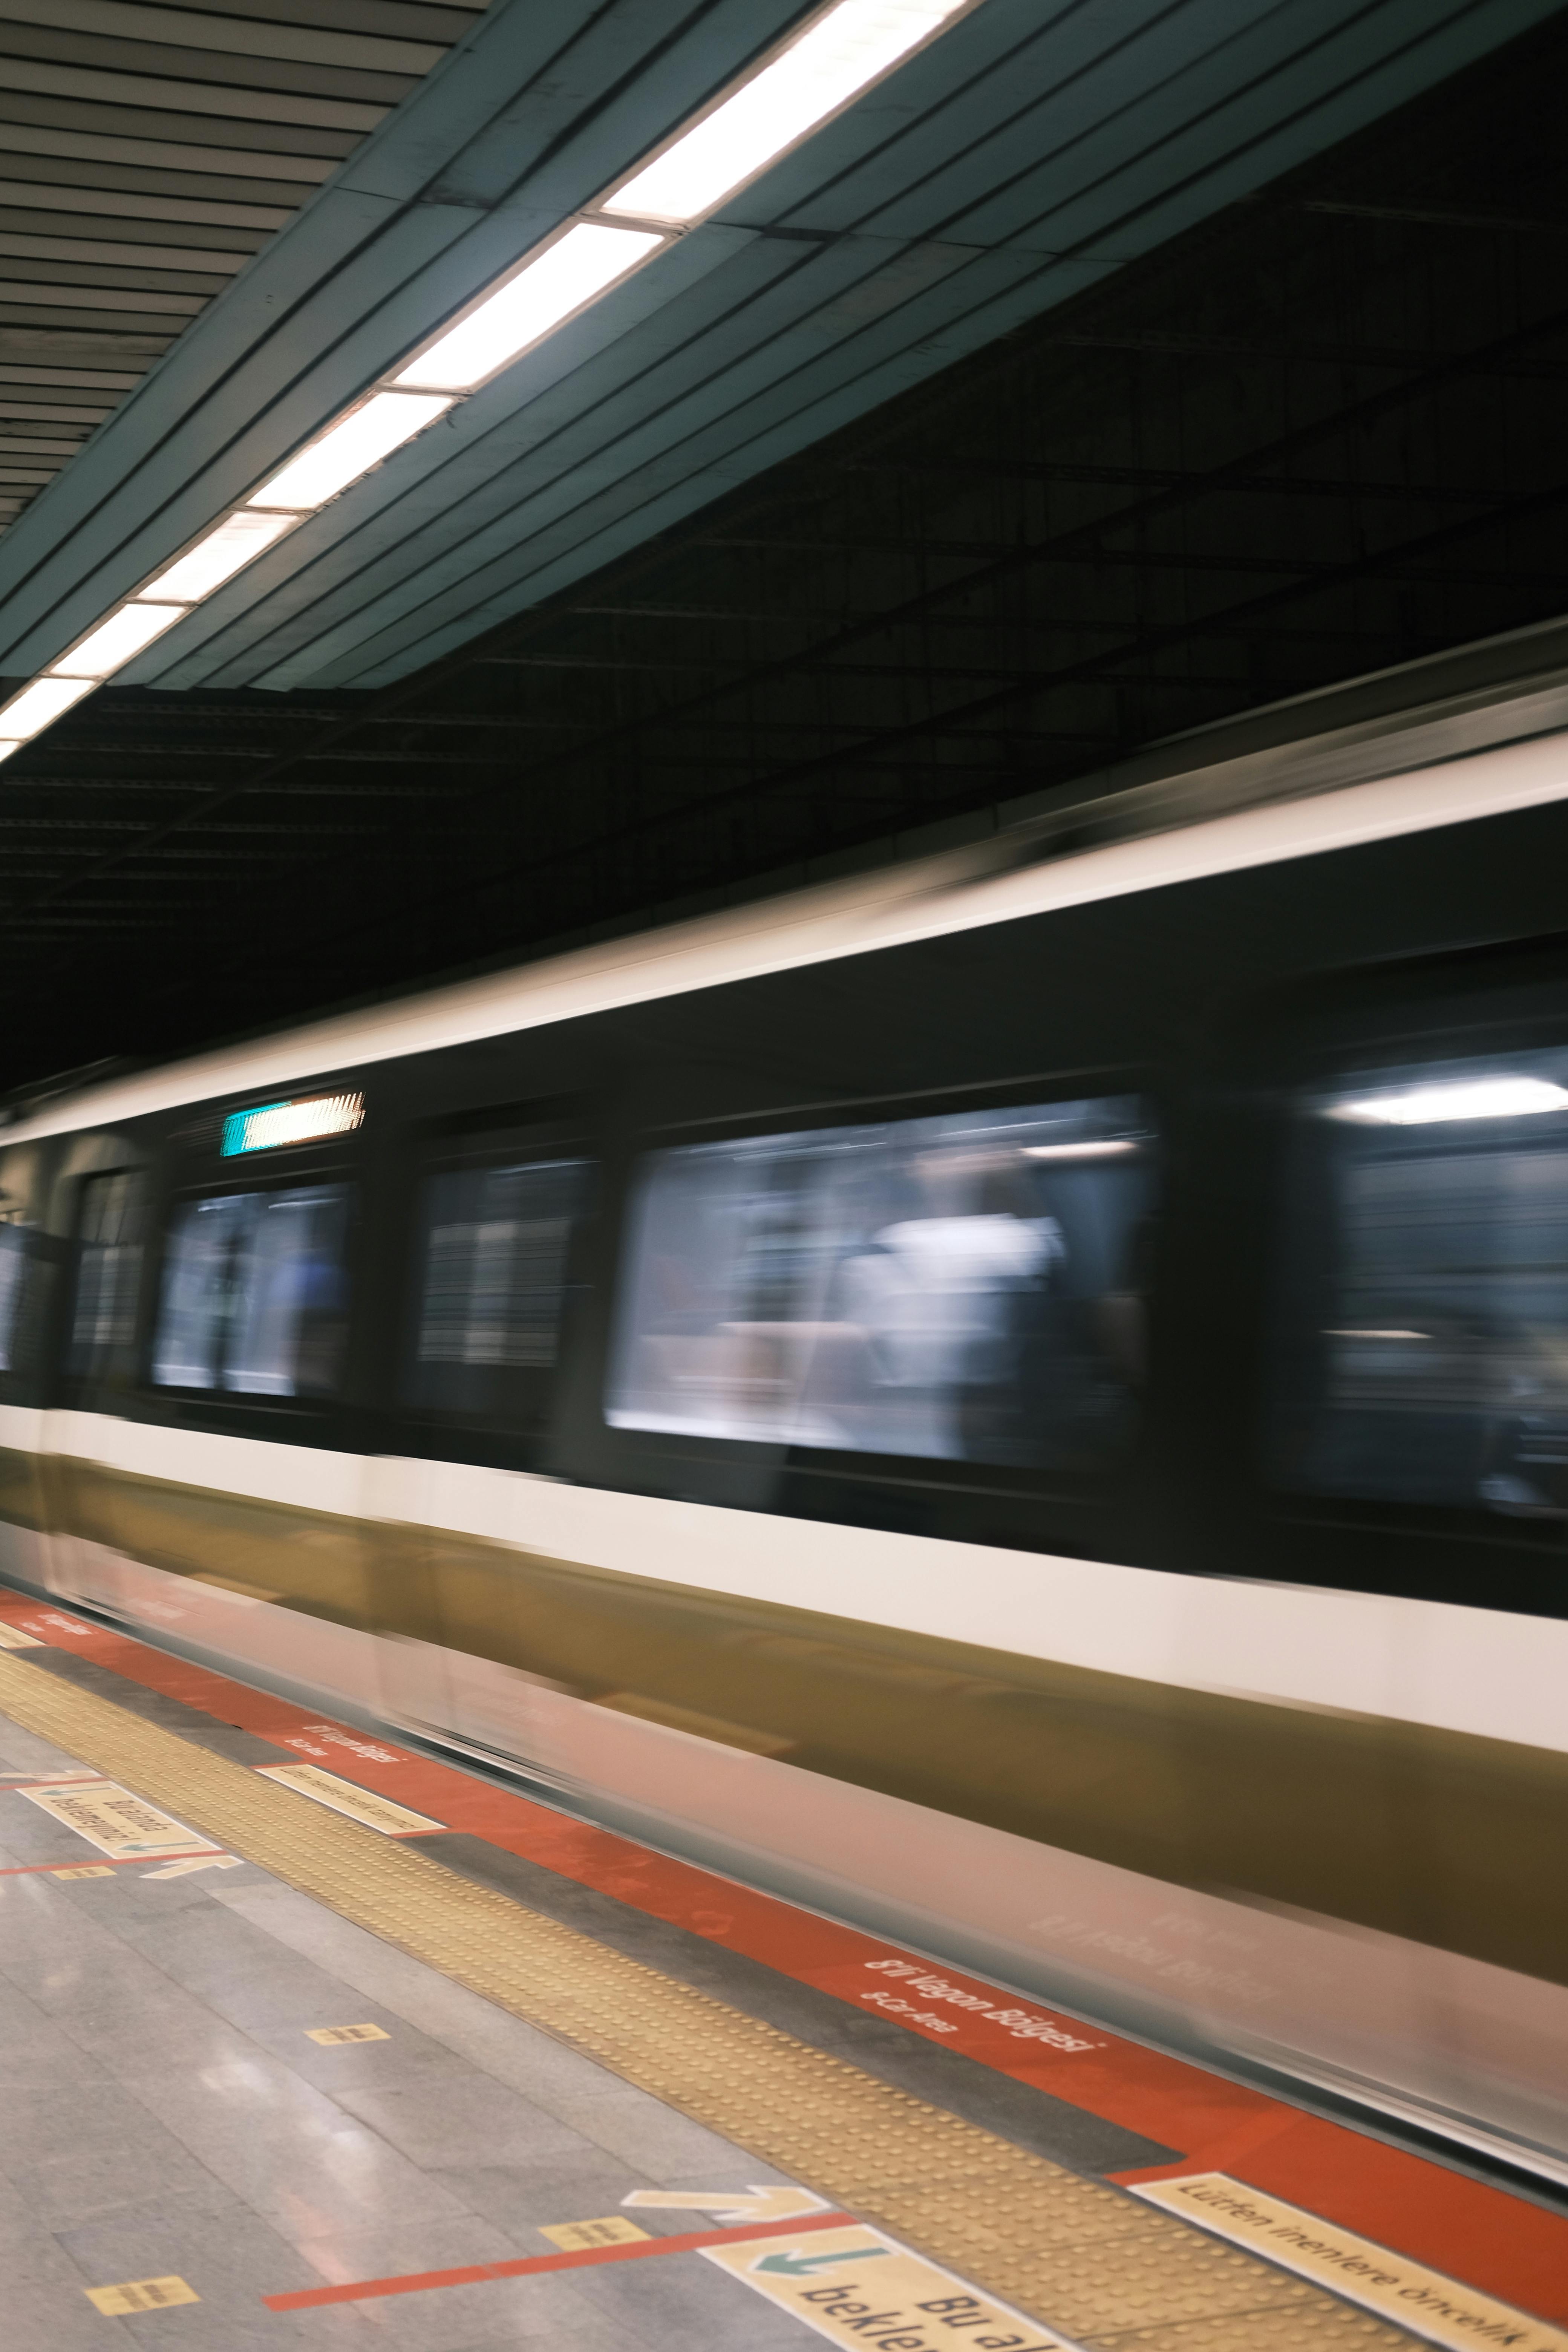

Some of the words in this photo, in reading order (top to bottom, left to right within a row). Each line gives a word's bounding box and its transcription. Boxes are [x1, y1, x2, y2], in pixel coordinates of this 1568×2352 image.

[51, 1798, 141, 1842] beklemeyiniz!
[103, 1800, 136, 1809] Bu
[114, 1809, 173, 1831] alanda
[860, 1992, 917, 2012] 8-Car
[903, 2013, 959, 2033] Area
[905, 1975, 995, 2011] Vagon
[982, 2009, 1107, 2052] Bölgesi
[1179, 2184, 1272, 2228] Lütfen
[1269, 2226, 1400, 2287] inenlere
[1398, 2287, 1529, 2346] öncelik
[798, 2285, 938, 2352] bekle
[916, 2296, 992, 2328] Bu
